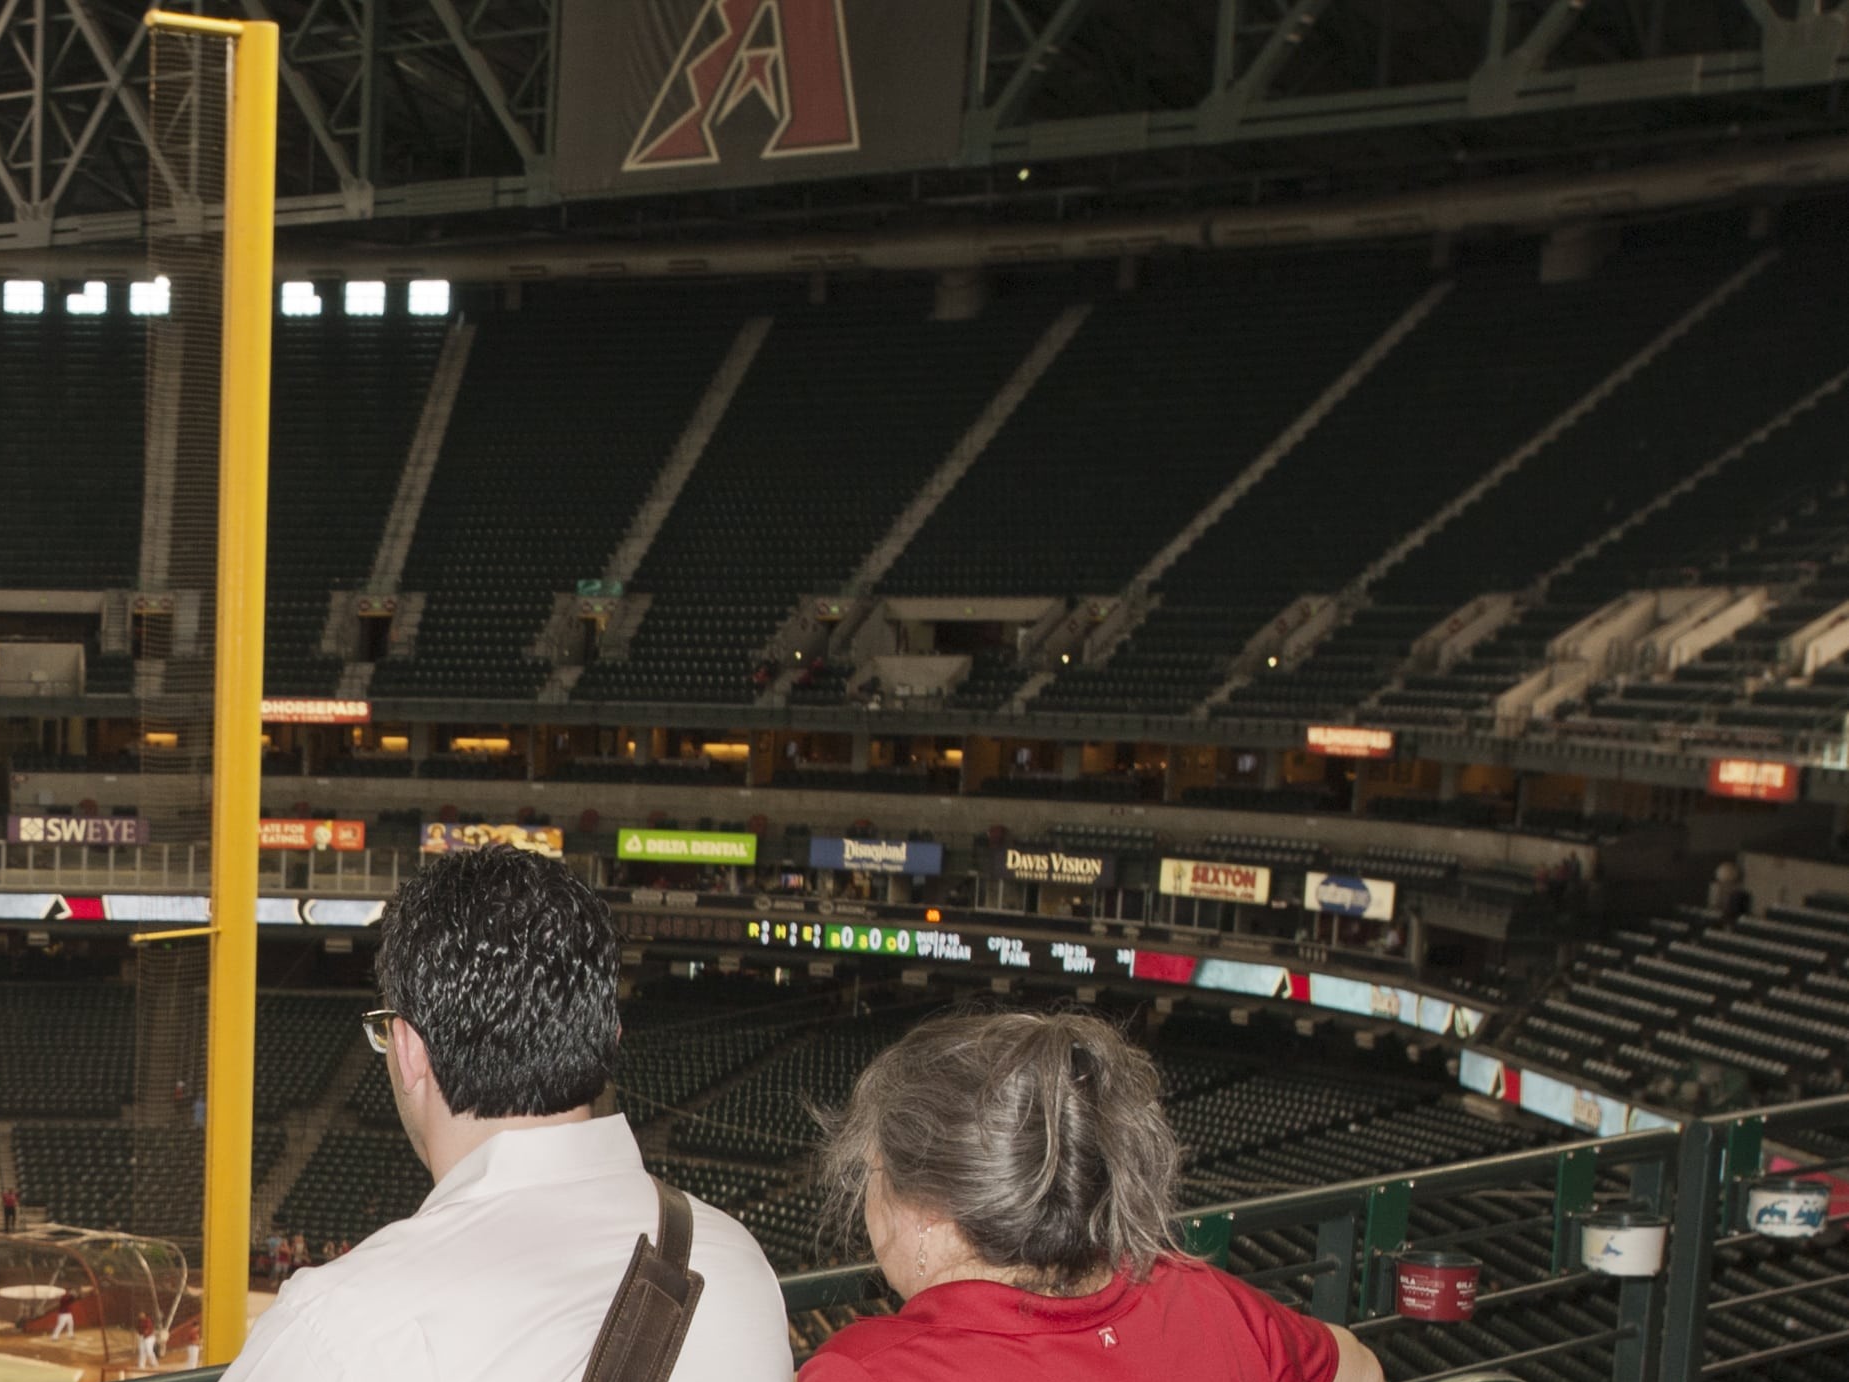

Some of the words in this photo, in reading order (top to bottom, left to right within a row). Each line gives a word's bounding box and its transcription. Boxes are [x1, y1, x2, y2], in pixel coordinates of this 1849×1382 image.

[645, 839, 689, 855] DELTA
[691, 841, 748, 858] DENTAL
[843, 838, 907, 863] Disneyland
[1191, 863, 1256, 889] SEXTON
